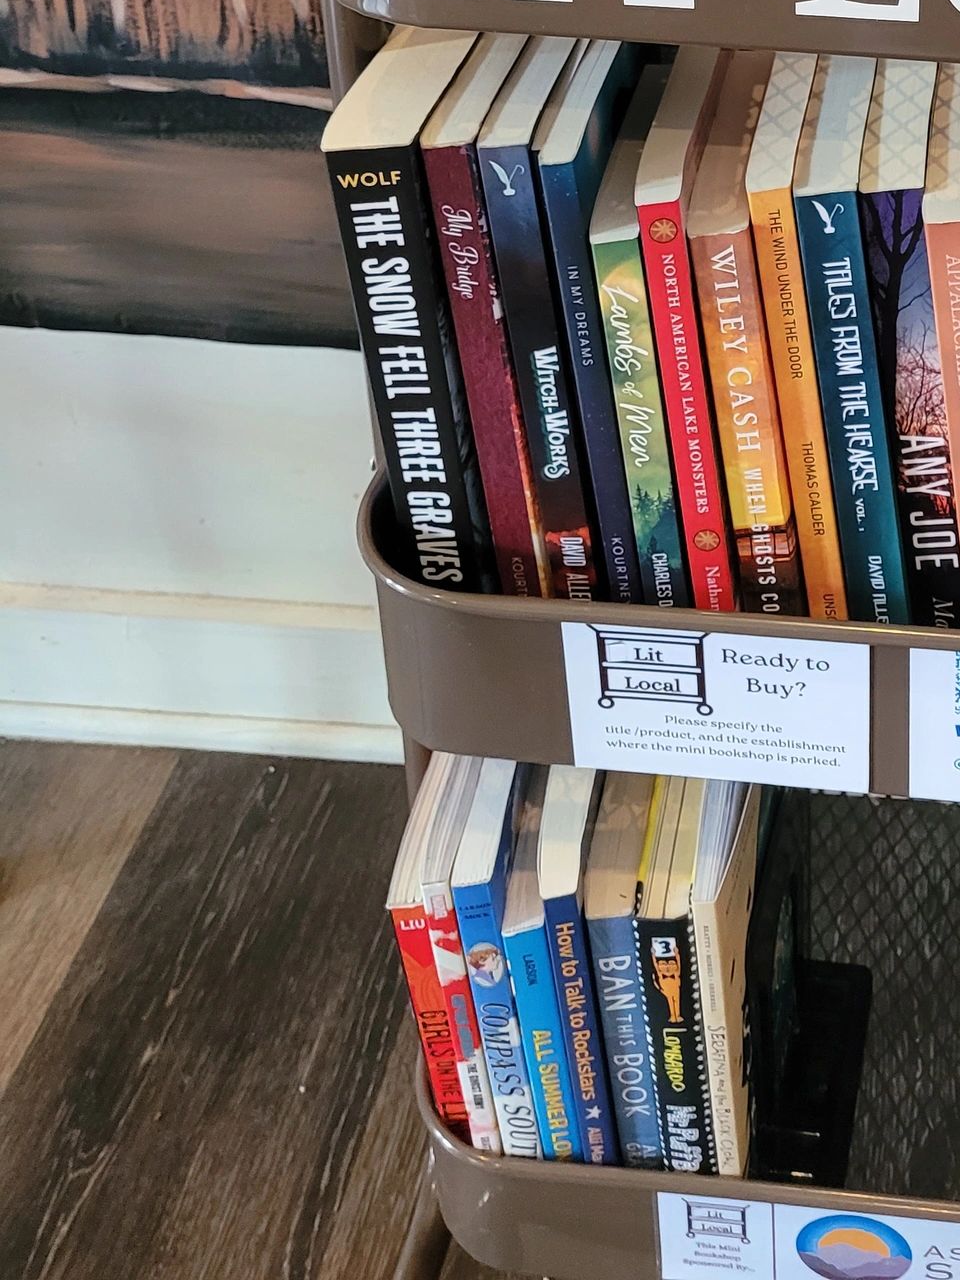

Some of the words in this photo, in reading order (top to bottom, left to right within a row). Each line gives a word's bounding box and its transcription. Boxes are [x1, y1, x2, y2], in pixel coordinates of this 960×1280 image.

[336, 170, 401, 189] WOLF
[350, 195, 406, 249] THE
[441, 204, 474, 238] My
[768, 208, 783, 235] THE
[448, 241, 480, 300] Bridge
[566, 265, 579, 280] IN
[771, 237, 789, 271] WIND
[361, 256, 422, 337] SNOW
[570, 286, 584, 306] MY
[661, 253, 681, 308] NORTH
[710, 244, 749, 354] WILEY
[778, 274, 794, 317] UNDER
[822, 256, 857, 320] TALES
[573, 311, 594, 366] DREAMS
[601, 283, 649, 377] Lambs
[670, 312, 693, 391] AMERICAN
[783, 318, 799, 345] THE
[830, 325, 864, 377] FROM
[378, 344, 432, 400] FELL
[786, 345, 803, 380] DOOR
[621, 380, 644, 399] of
[727, 366, 762, 453] CASH
[838, 381, 870, 423] THE
[619, 400, 656, 468] Men
[681, 397, 699, 435] LAKE
[390, 407, 447, 484] THREE
[801, 440, 819, 490] THOMAS
[843, 423, 879, 495] HEARSE
[899, 434, 951, 498] ANY
[687, 438, 710, 515] MONSTERS
[743, 467, 767, 515] WHEN
[406, 490, 464, 583] GRAVES
[808, 490, 826, 537] CALDER
[559, 536, 587, 568] DAVID
[750, 523, 777, 585] GHOSTS
[909, 510, 960, 571] JOE
[651, 552, 673, 599] CHARLES
[867, 555, 886, 591] DAVID
[633, 647, 664, 663] Lit
[721, 648, 800, 673] Ready
[806, 656, 830, 671] to
[624, 676, 682, 693] Local
[745, 677, 806, 699] Buy?
[605, 725, 631, 736] title
[698, 731, 724, 742] and
[726, 733, 749, 744] the
[750, 735, 847, 754] establishment
[664, 714, 709, 727] Please
[710, 718, 758, 733] specify
[760, 723, 783, 734] the
[606, 738, 648, 750] where
[650, 740, 673, 752] the
[675, 744, 706, 754] mini
[709, 745, 774, 762] bookshop
[776, 752, 788, 763] is
[790, 752, 841, 768] parked.
[400, 917, 426, 931] LIU
[555, 922, 576, 958] How
[561, 959, 580, 977] to
[598, 955, 638, 1011] BAN
[564, 977, 587, 1011] Talk
[419, 1010, 456, 1058] GIRLS
[569, 1011, 588, 1029] to
[616, 1013, 637, 1046] THIS
[481, 1002, 525, 1098] COMPASS
[532, 1030, 555, 1062] ALL
[571, 1029, 597, 1101] Rockstars
[662, 1027, 688, 1093] LOMBARDO
[539, 1063, 569, 1130] SUMMER
[613, 1053, 651, 1118] BOOK
[701, 1223, 734, 1234] Local
